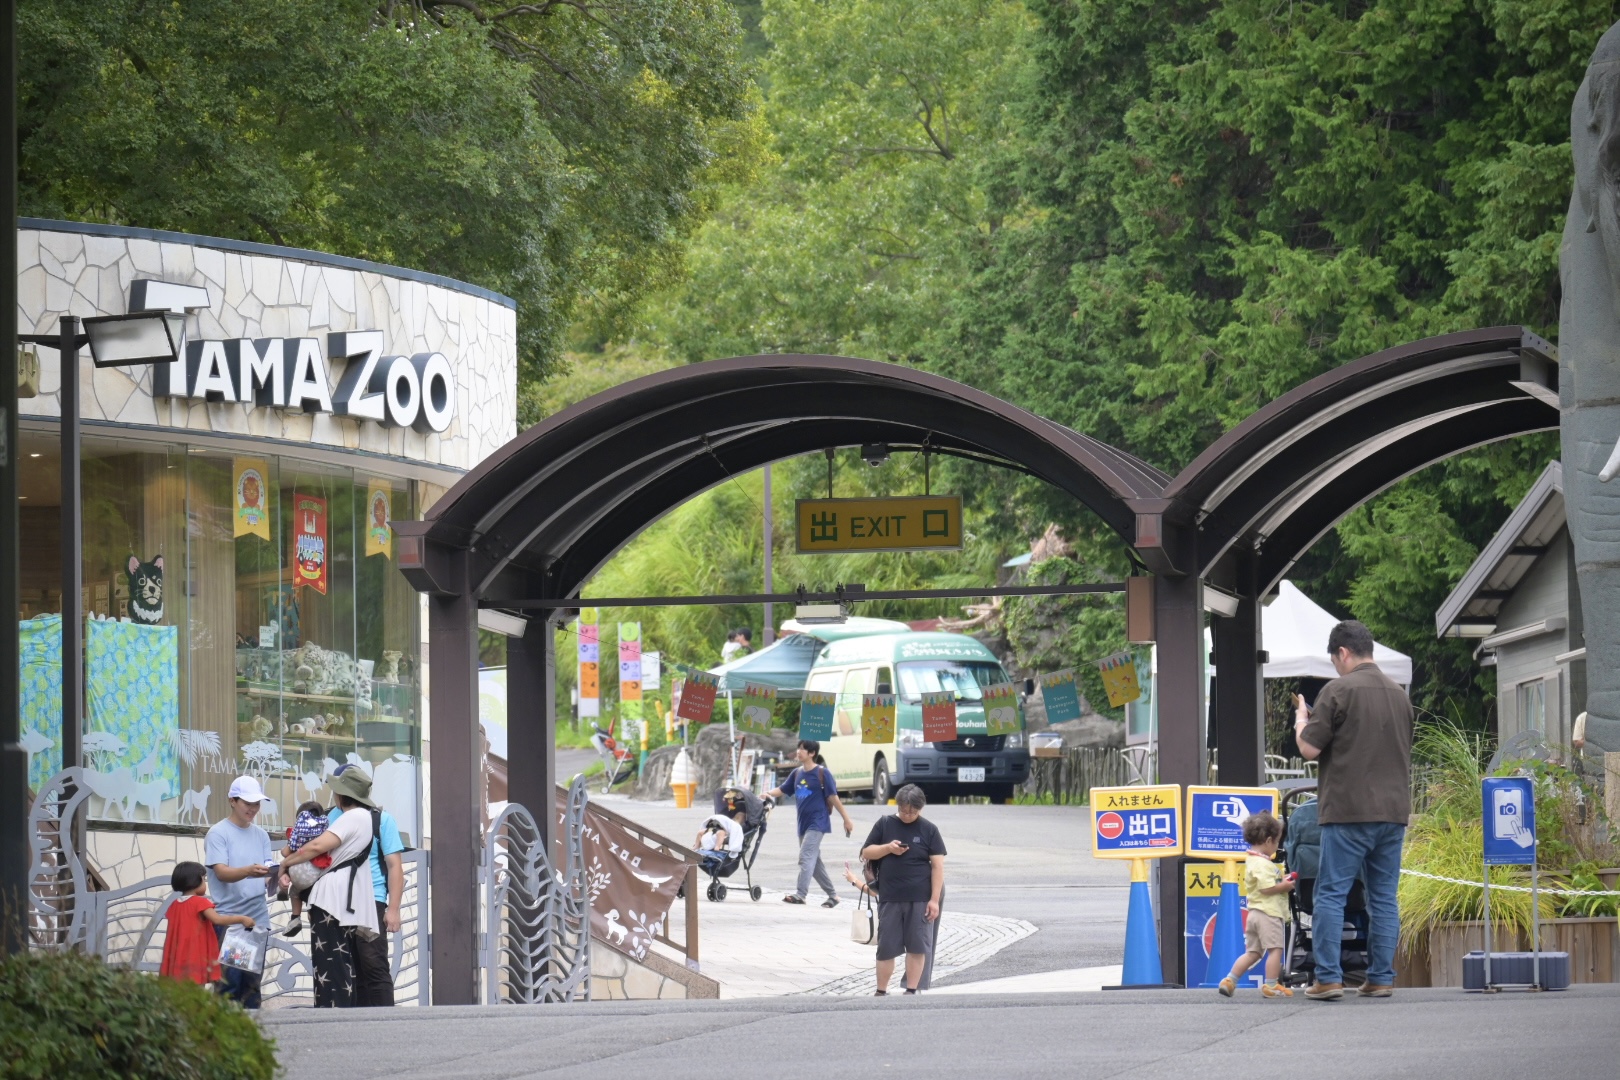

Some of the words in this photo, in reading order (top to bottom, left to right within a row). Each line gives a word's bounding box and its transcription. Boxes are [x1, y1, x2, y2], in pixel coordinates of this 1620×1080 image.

[130, 279, 333, 413] TAMA
[851, 516, 906, 537] EXIT
[683, 699, 710, 709] Zoological
[201, 755, 238, 775] TAMA
[239, 759, 272, 776] ZOO
[1108, 795, 1163, 807] 入れません
[1129, 813, 1170, 836] 出口
[560, 813, 600, 845] TMA
[608, 842, 641, 868] ZOO
